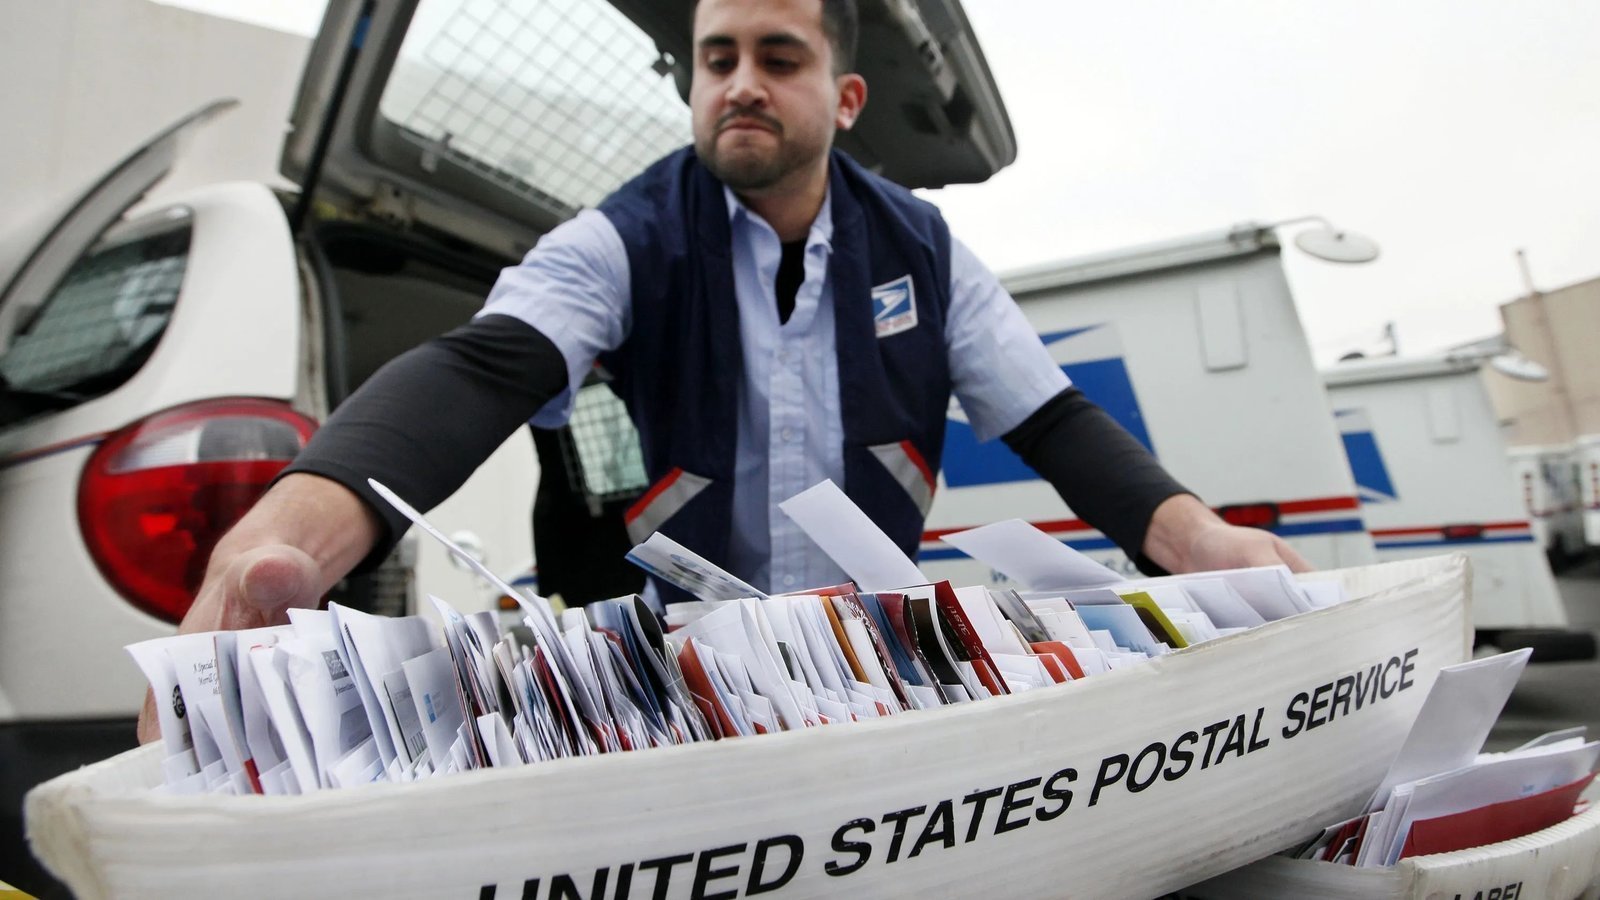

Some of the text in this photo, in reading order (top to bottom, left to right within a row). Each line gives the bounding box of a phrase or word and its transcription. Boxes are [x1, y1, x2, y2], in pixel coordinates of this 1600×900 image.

[824, 767, 1078, 877] STATES
[1088, 707, 1270, 807] POSTAL
[1282, 648, 1419, 740] SERVICE
